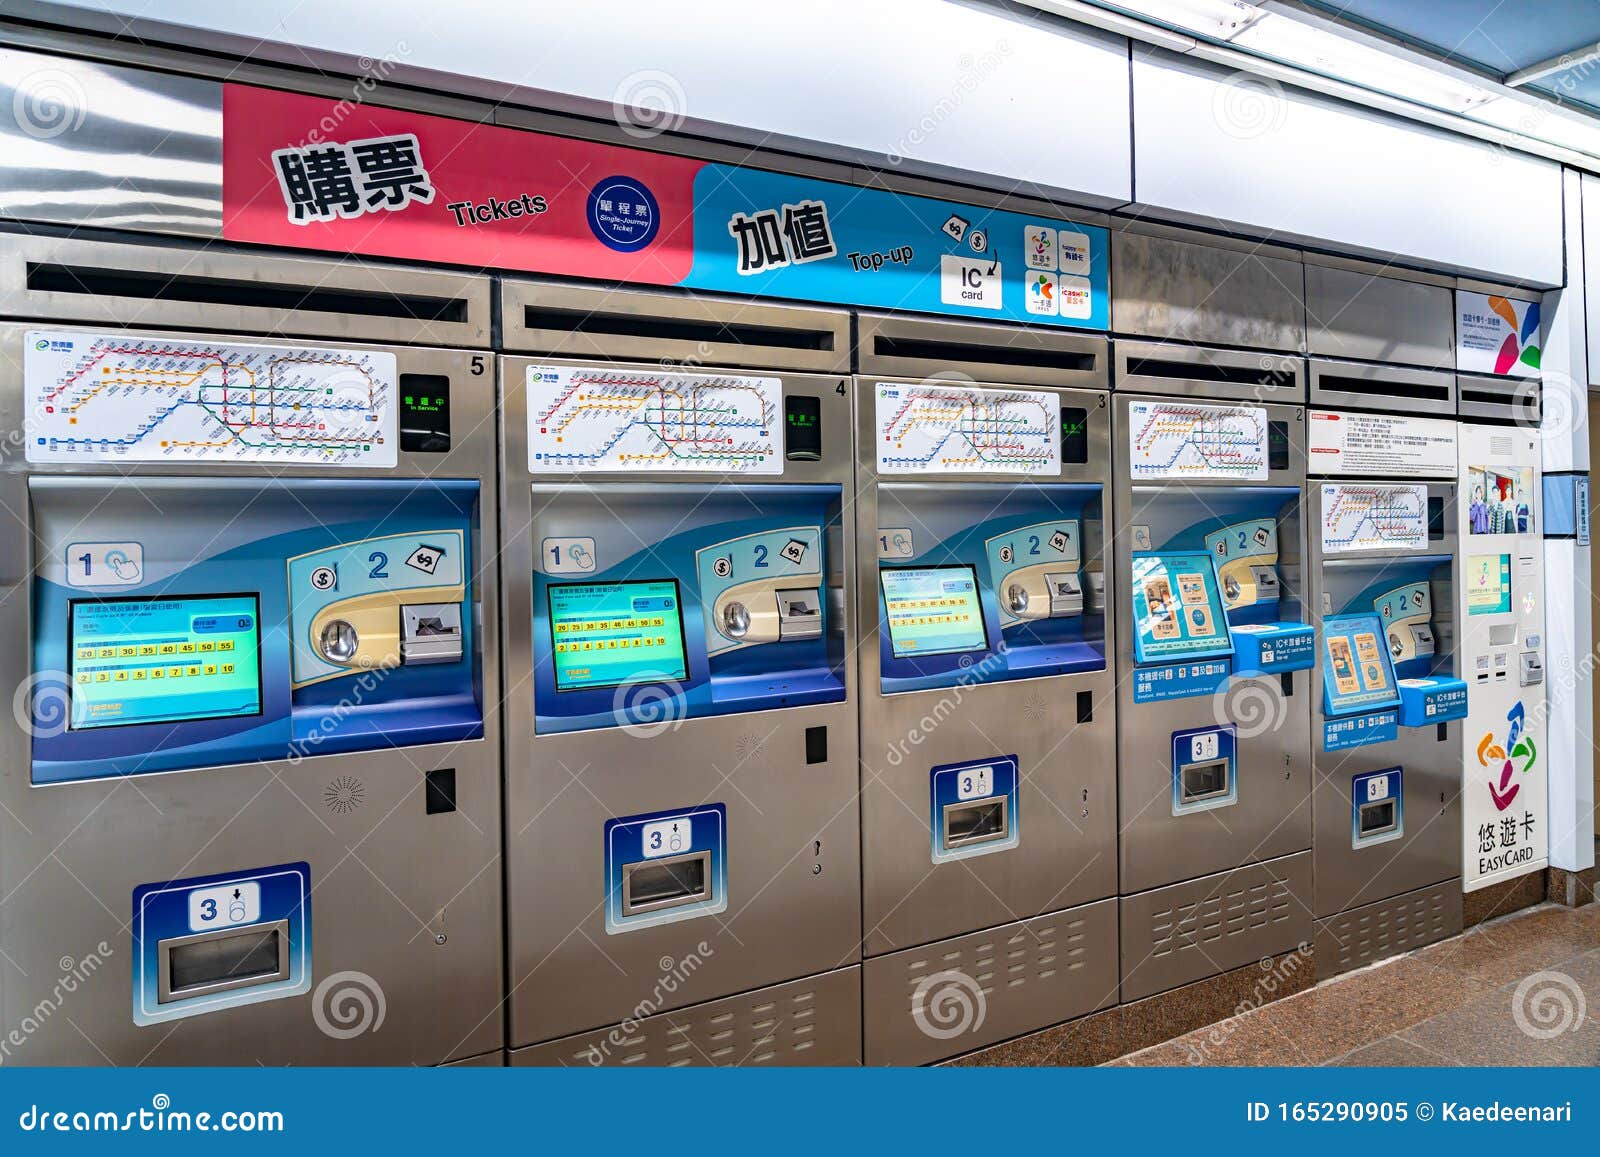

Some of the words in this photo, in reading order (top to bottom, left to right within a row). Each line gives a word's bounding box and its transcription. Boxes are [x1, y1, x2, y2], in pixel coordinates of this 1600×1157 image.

[276, 136, 433, 224] 購票
[448, 193, 548, 226] Tickets
[600, 199, 648, 217] 單程票
[599, 214, 649, 227] Single-Journey
[612, 223, 633, 233] Ticket
[730, 202, 835, 273] 加值
[847, 245, 914, 273] Top-up
[961, 266, 983, 288] IC
[961, 290, 983, 301] card
[470, 356, 485, 376] 5
[835, 380, 846, 396] 4
[1098, 394, 1106, 409] 3
[1296, 408, 1303, 421] 2
[880, 535, 888, 552] 1
[1028, 535, 1041, 555] 2
[1238, 531, 1247, 549] 2
[79, 553, 92, 576] 1
[551, 546, 560, 565] 1
[754, 544, 769, 568] 2
[368, 551, 389, 579] 2
[1400, 596, 1407, 611] 2
[1195, 741, 1203, 756] 3
[963, 776, 973, 793] 3
[1370, 784, 1376, 796] 3
[650, 831, 662, 849] 3
[1478, 810, 1536, 854] 悠遊卡
[200, 898, 217, 921] 3
